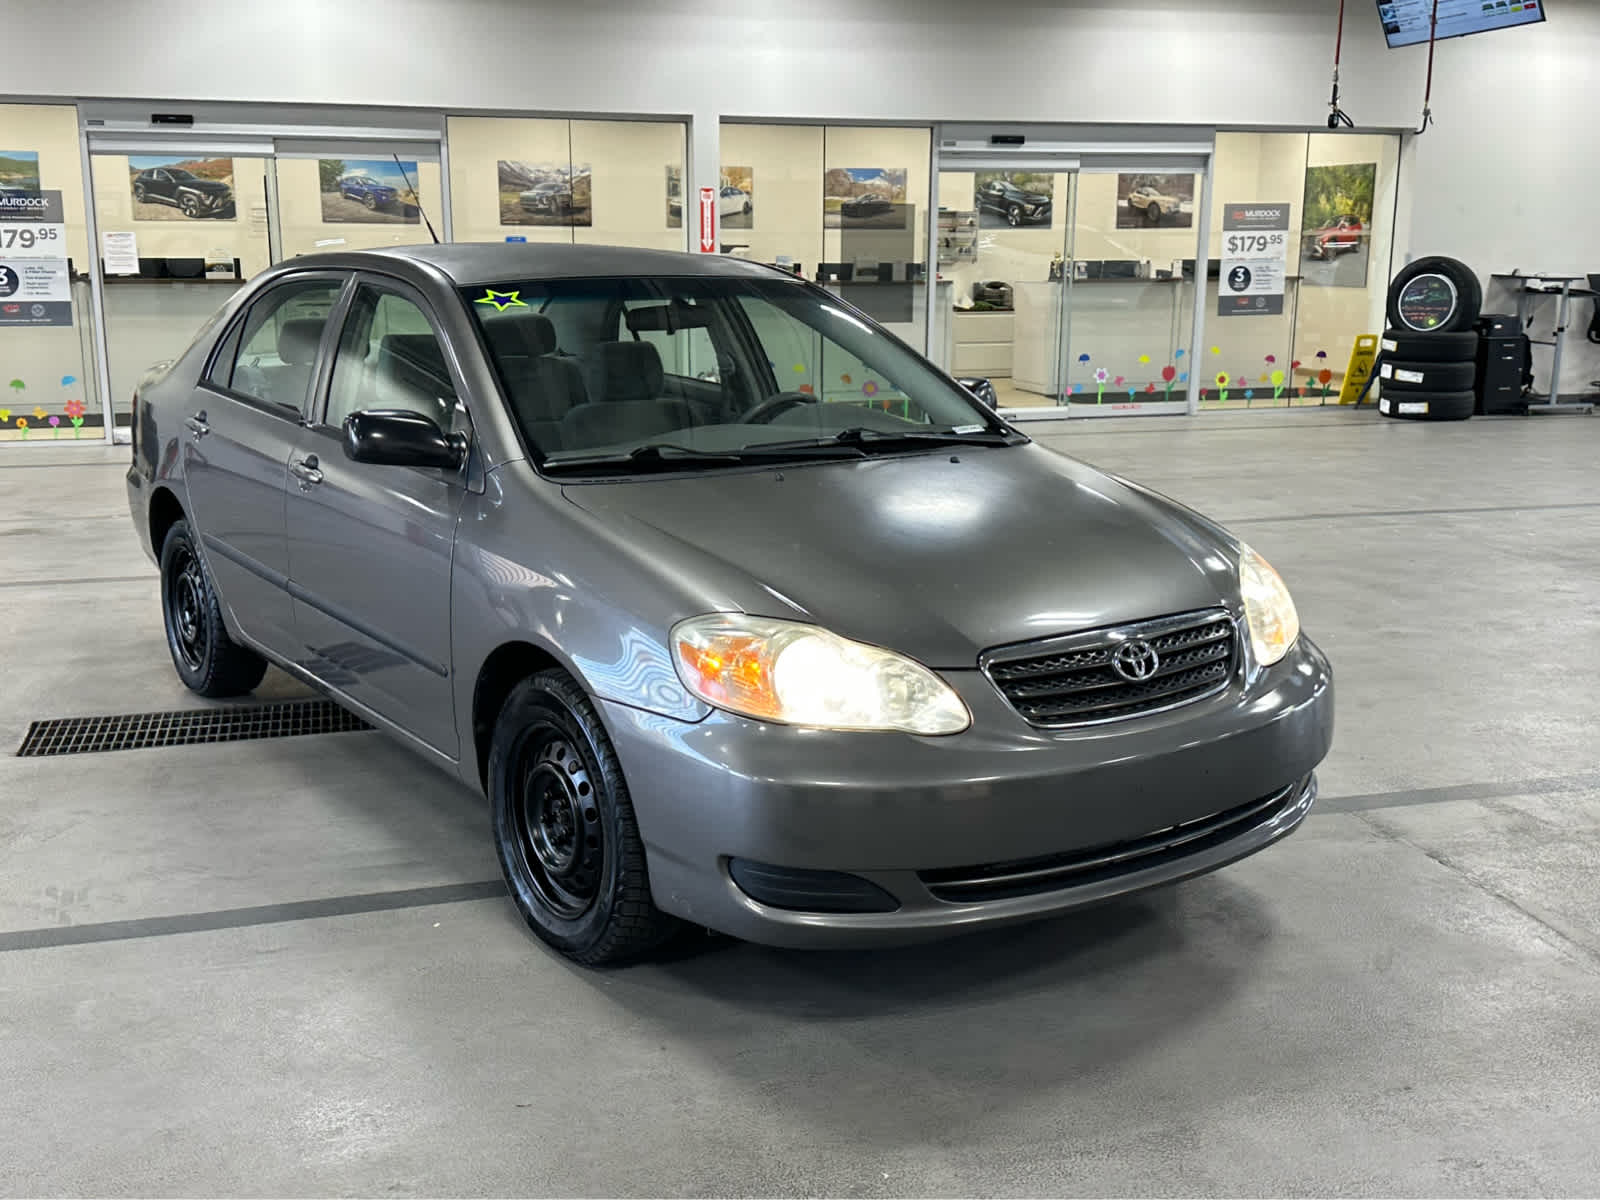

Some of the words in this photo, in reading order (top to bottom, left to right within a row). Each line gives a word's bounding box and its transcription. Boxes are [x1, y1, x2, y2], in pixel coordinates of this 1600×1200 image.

[0, 228, 57, 248] 79.95
[1228, 235, 1282, 253] $179.95
[1234, 268, 1245, 282] 3
